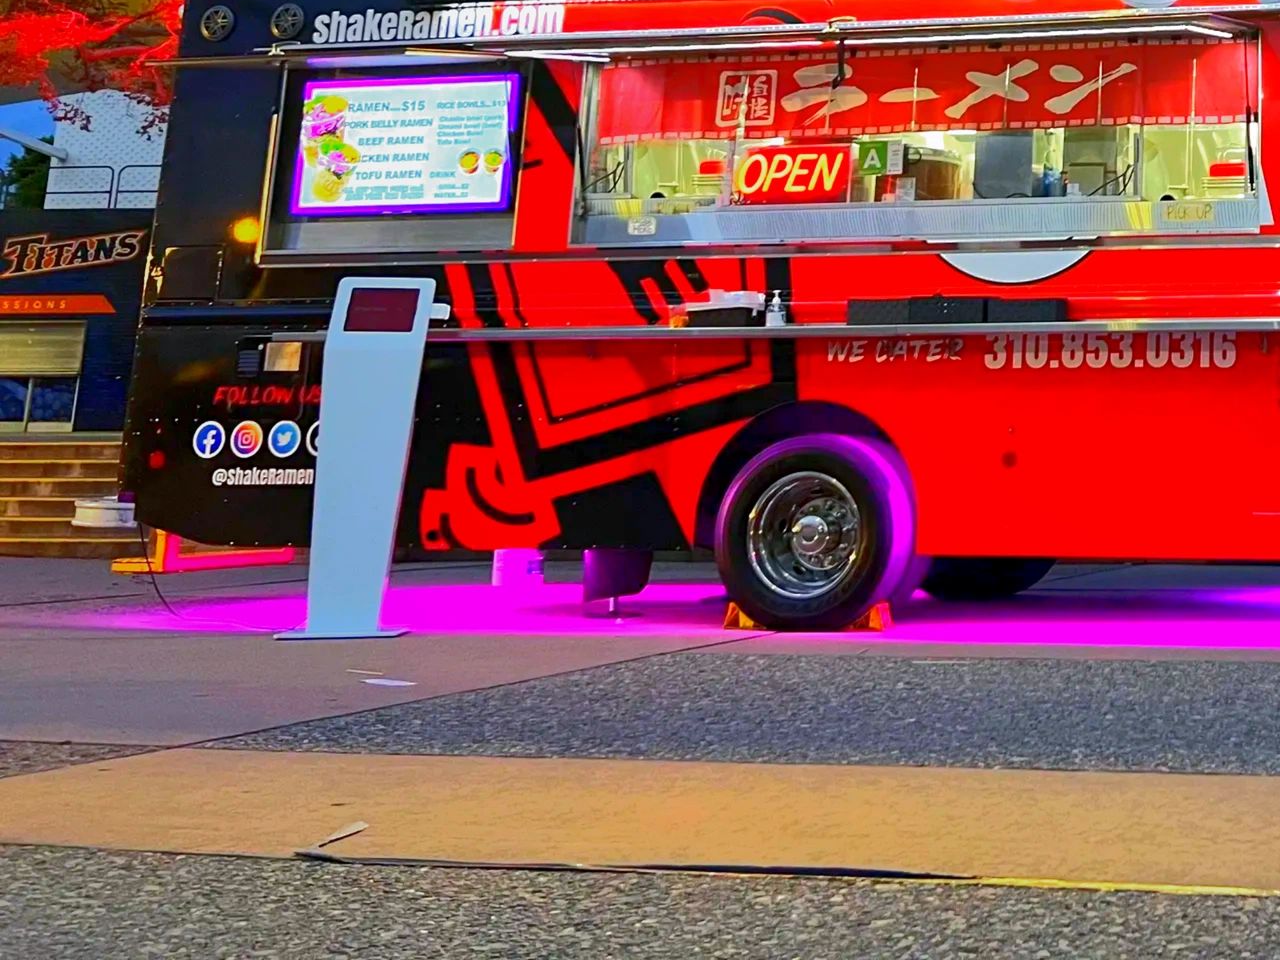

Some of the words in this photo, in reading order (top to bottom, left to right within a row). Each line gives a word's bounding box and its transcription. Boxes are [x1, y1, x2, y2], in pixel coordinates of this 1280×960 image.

[780, 58, 1139, 127] ラーメン
[370, 119, 398, 129] BELLY
[400, 118, 433, 128] RAMEN
[358, 136, 385, 147] BEEF
[387, 135, 425, 146] RAMEN
[391, 152, 430, 162] RAMEN
[862, 147, 882, 169] A
[355, 171, 383, 181] TOFU
[384, 169, 423, 180] RAMEN
[736, 151, 844, 195] OPEN
[3, 232, 143, 275] TITANS
[827, 339, 869, 363] WE
[984, 331, 1237, 369] 310.853.0316
[213, 385, 294, 405] FOLLOW
